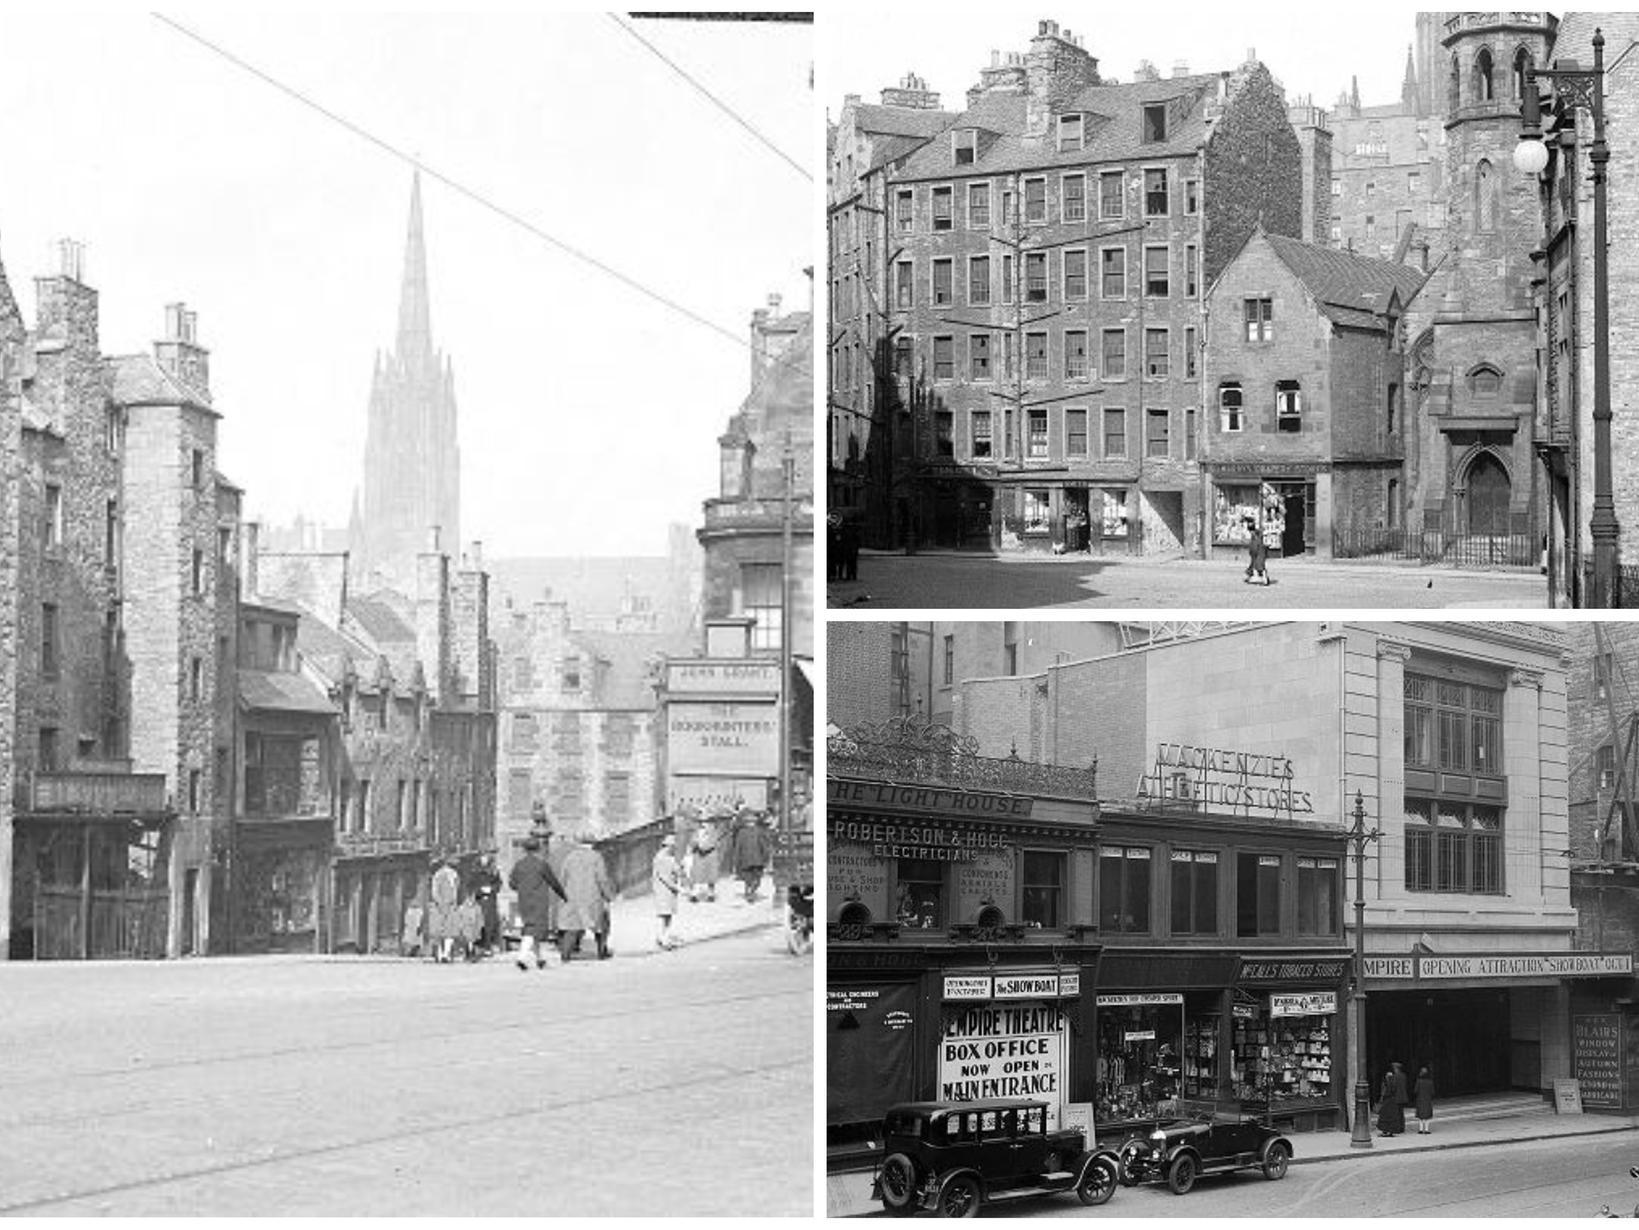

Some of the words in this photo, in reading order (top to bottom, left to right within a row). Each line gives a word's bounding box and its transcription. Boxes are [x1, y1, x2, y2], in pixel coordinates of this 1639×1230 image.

[1241, 784, 1313, 813] STORES
[833, 820, 945, 847] ROBERTSON
[951, 830, 961, 848] &
[966, 831, 1009, 851] HOGG
[873, 844, 978, 862] ELECTRICIANS
[829, 883, 880, 893] IGHTING
[1363, 959, 1411, 976] MPIRE
[1421, 958, 1472, 976] OPENING
[1479, 957, 1545, 974] ATTRACTION
[945, 1009, 1001, 1037] EMPIRE
[1004, 1007, 1064, 1035] THEATRE
[945, 1042, 981, 1062] BOX
[984, 1038, 1049, 1059] OFFICE
[1578, 1039, 1617, 1049] WINDOW
[961, 1064, 991, 1077] NOW
[1002, 1060, 1039, 1074] OPEN
[1577, 1059, 1618, 1069] AUTUMN
[942, 1081, 979, 1101] MAIN
[982, 1072, 1057, 1098] ENTRANCE
